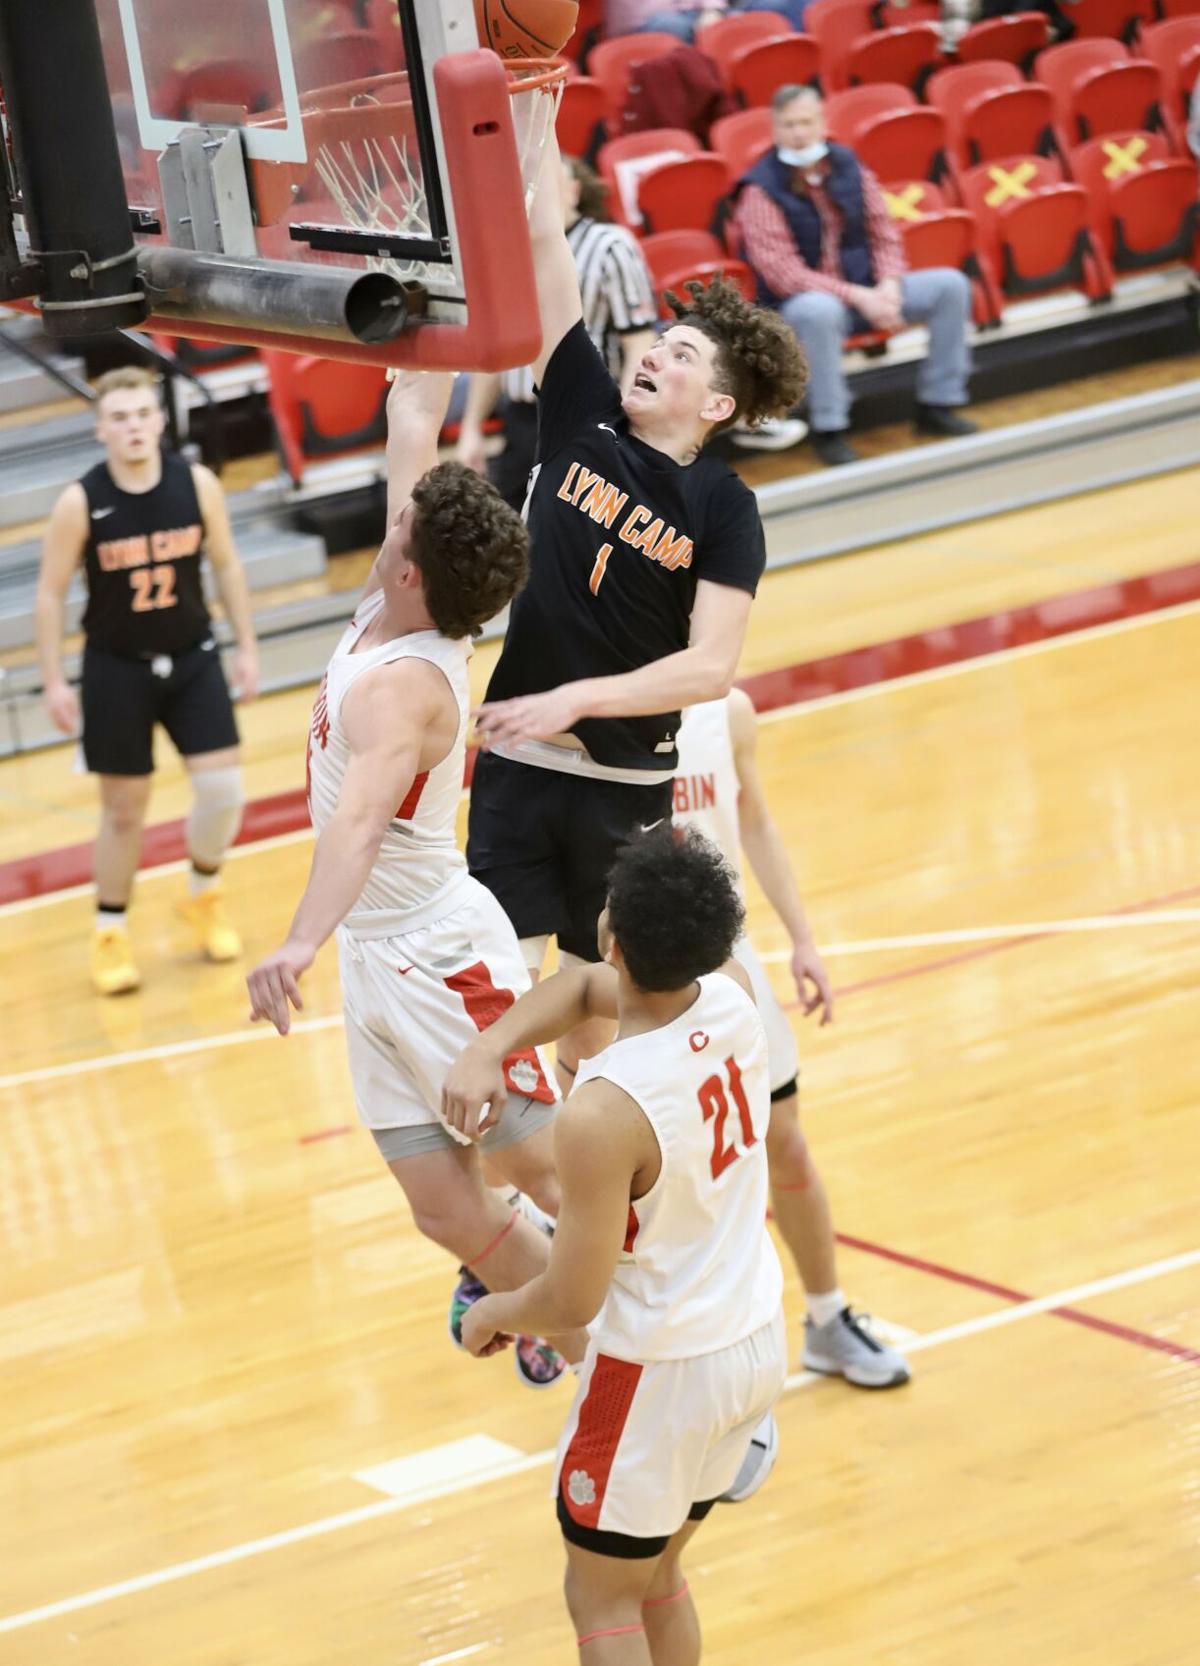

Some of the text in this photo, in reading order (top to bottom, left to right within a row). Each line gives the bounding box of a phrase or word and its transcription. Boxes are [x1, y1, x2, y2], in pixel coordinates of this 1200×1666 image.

[557, 461, 694, 571] LYNN CAMP
[129, 564, 178, 613] 22
[589, 542, 614, 596] 1
[697, 1053, 758, 1182] 21
